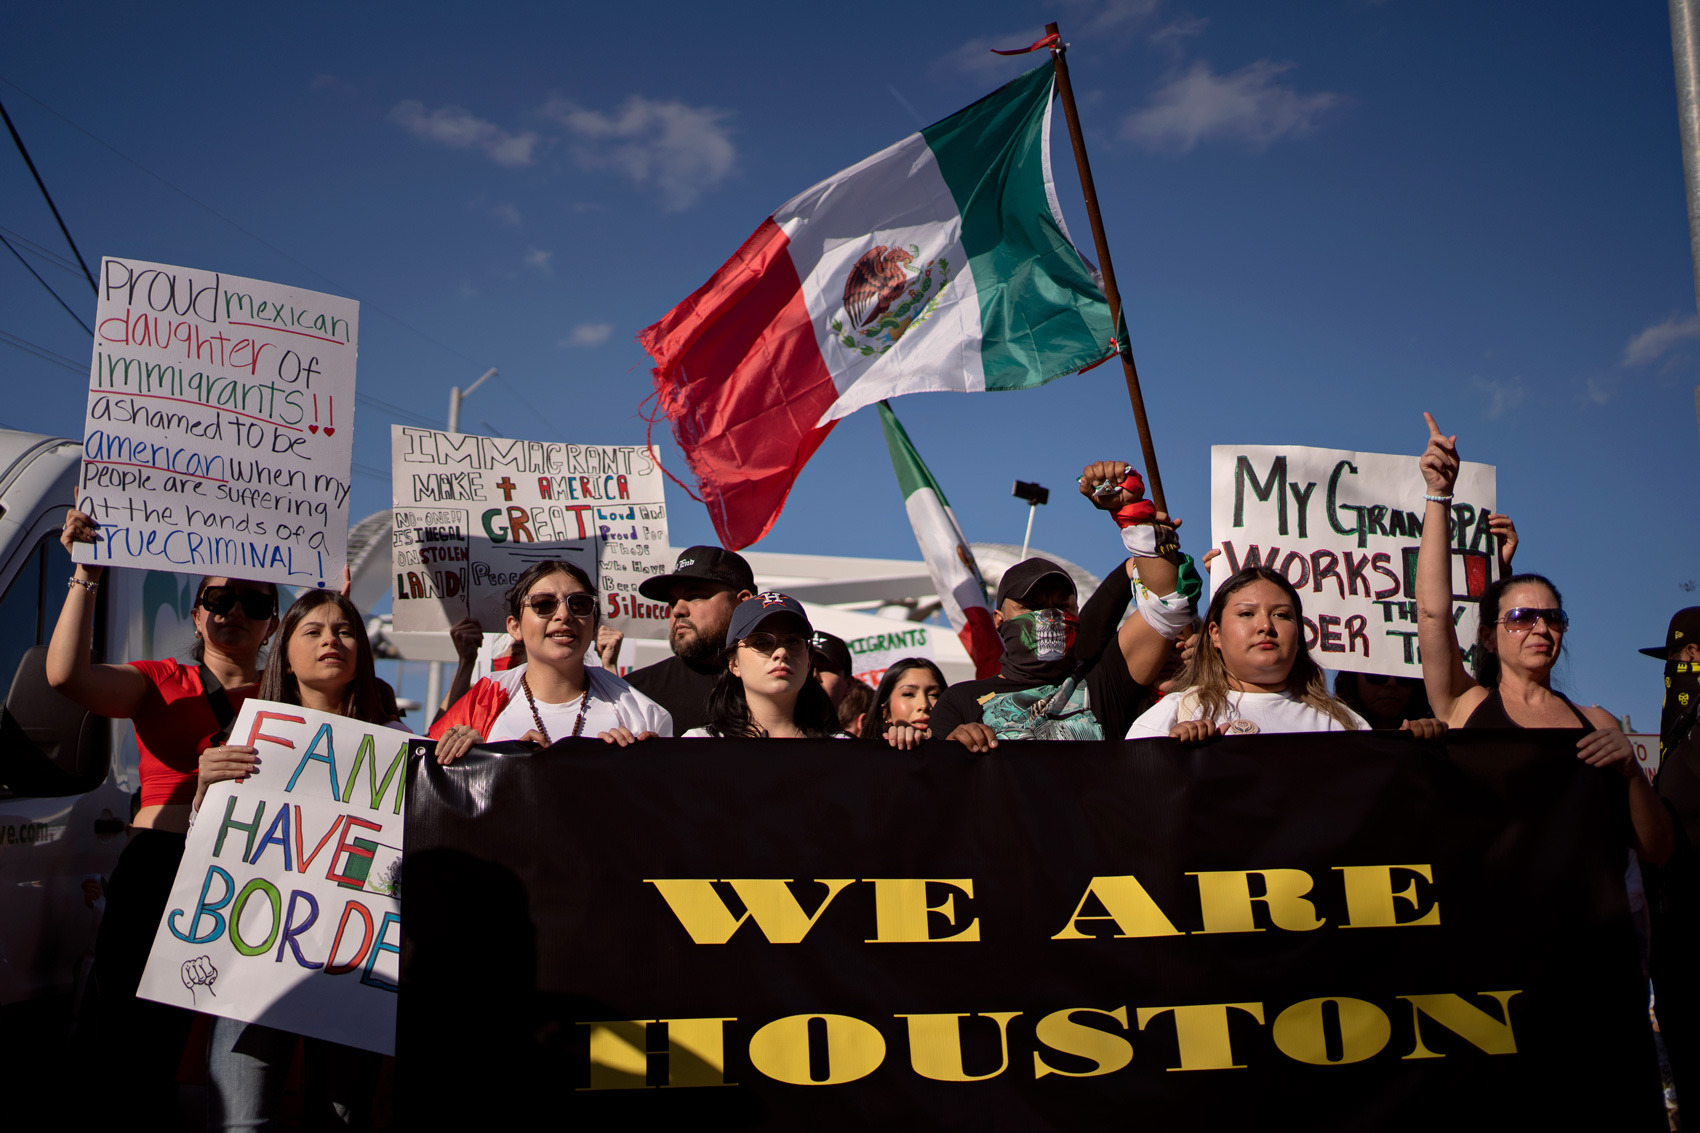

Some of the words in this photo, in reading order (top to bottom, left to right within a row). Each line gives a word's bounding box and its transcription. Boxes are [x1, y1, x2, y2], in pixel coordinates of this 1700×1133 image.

[104, 260, 219, 323] Proud
[225, 290, 350, 342] mexican
[98, 308, 277, 375] daughter
[91, 396, 223, 441] ashamed
[228, 417, 264, 448] to
[271, 428, 312, 460] be
[85, 430, 225, 480] american
[315, 474, 351, 510] my
[413, 472, 487, 502] MAKE
[538, 475, 630, 501] AMERICA
[164, 476, 207, 497] are
[216, 484, 328, 528] suffering
[482, 505, 591, 543] GREAT
[597, 506, 636, 521] Loud
[639, 505, 666, 520] And
[78, 496, 120, 520] at
[121, 497, 178, 526] the
[186, 504, 267, 535] hands
[309, 531, 330, 556] a
[393, 529, 413, 548] IS
[598, 525, 638, 541] Proud
[398, 550, 420, 567] ON
[420, 546, 469, 564] STOLEN
[599, 560, 627, 572] Who
[632, 560, 666, 575] Have
[605, 542, 650, 556] Those
[1221, 541, 1401, 600] WORKS
[397, 567, 467, 603] LAND!
[602, 576, 639, 592] Been
[607, 593, 672, 620] Silenced
[212, 795, 382, 888] HAVE
[643, 877, 981, 944] WE
[1051, 863, 1441, 939] ARE
[168, 865, 401, 992] BORDE
[575, 990, 1523, 1091] HOUSTON
